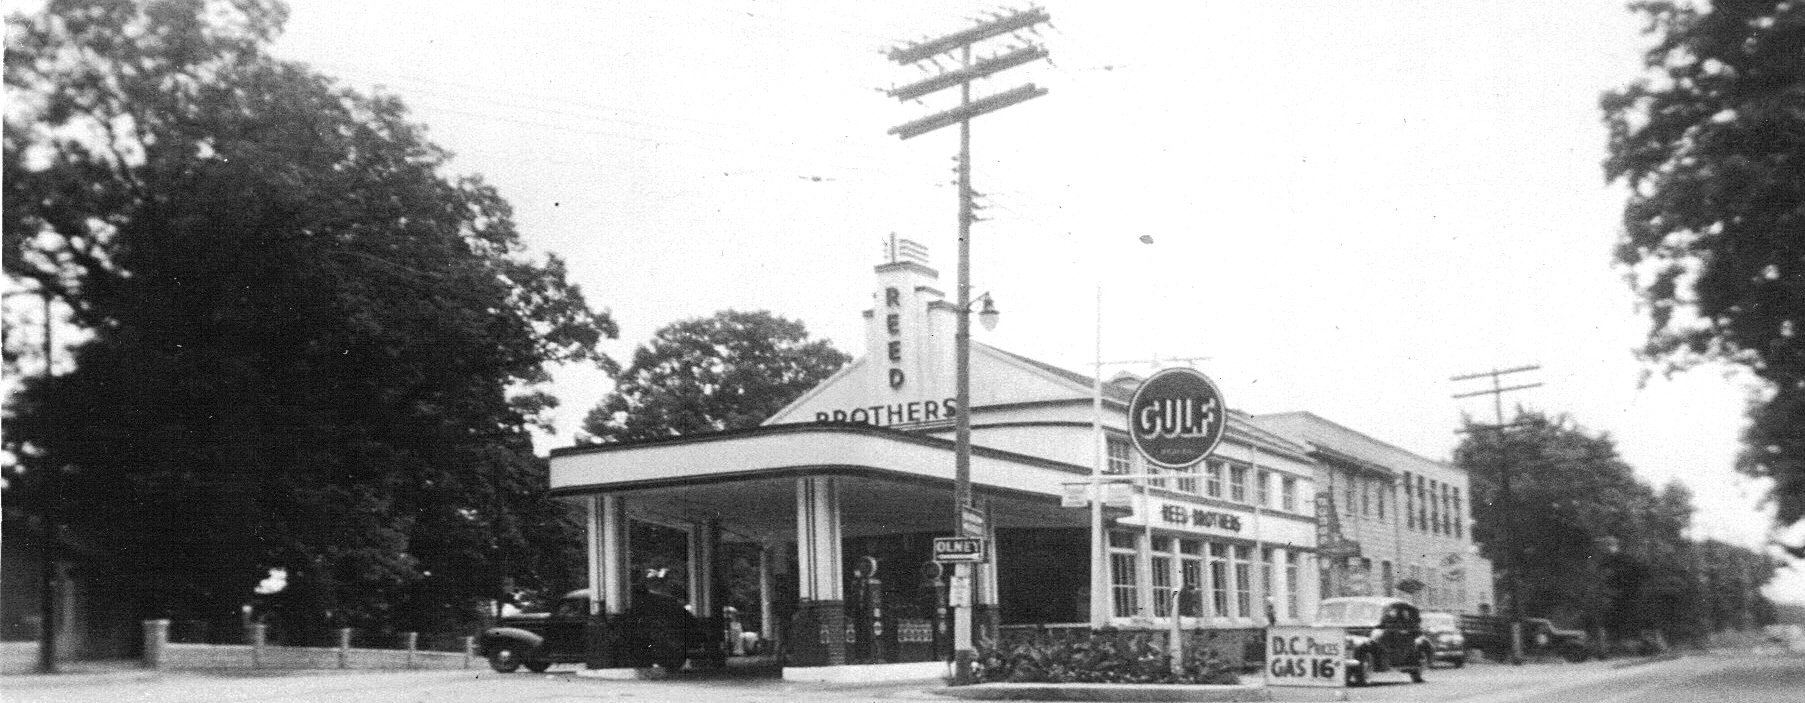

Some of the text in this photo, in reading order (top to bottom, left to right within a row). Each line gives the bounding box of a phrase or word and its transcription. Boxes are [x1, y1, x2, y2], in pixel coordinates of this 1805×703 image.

[885, 287, 905, 391] REED
[1140, 397, 1216, 439] GULF
[1162, 504, 1188, 524] REED
[936, 541, 979, 553] OLNEY
[1271, 658, 1306, 677] GAS
